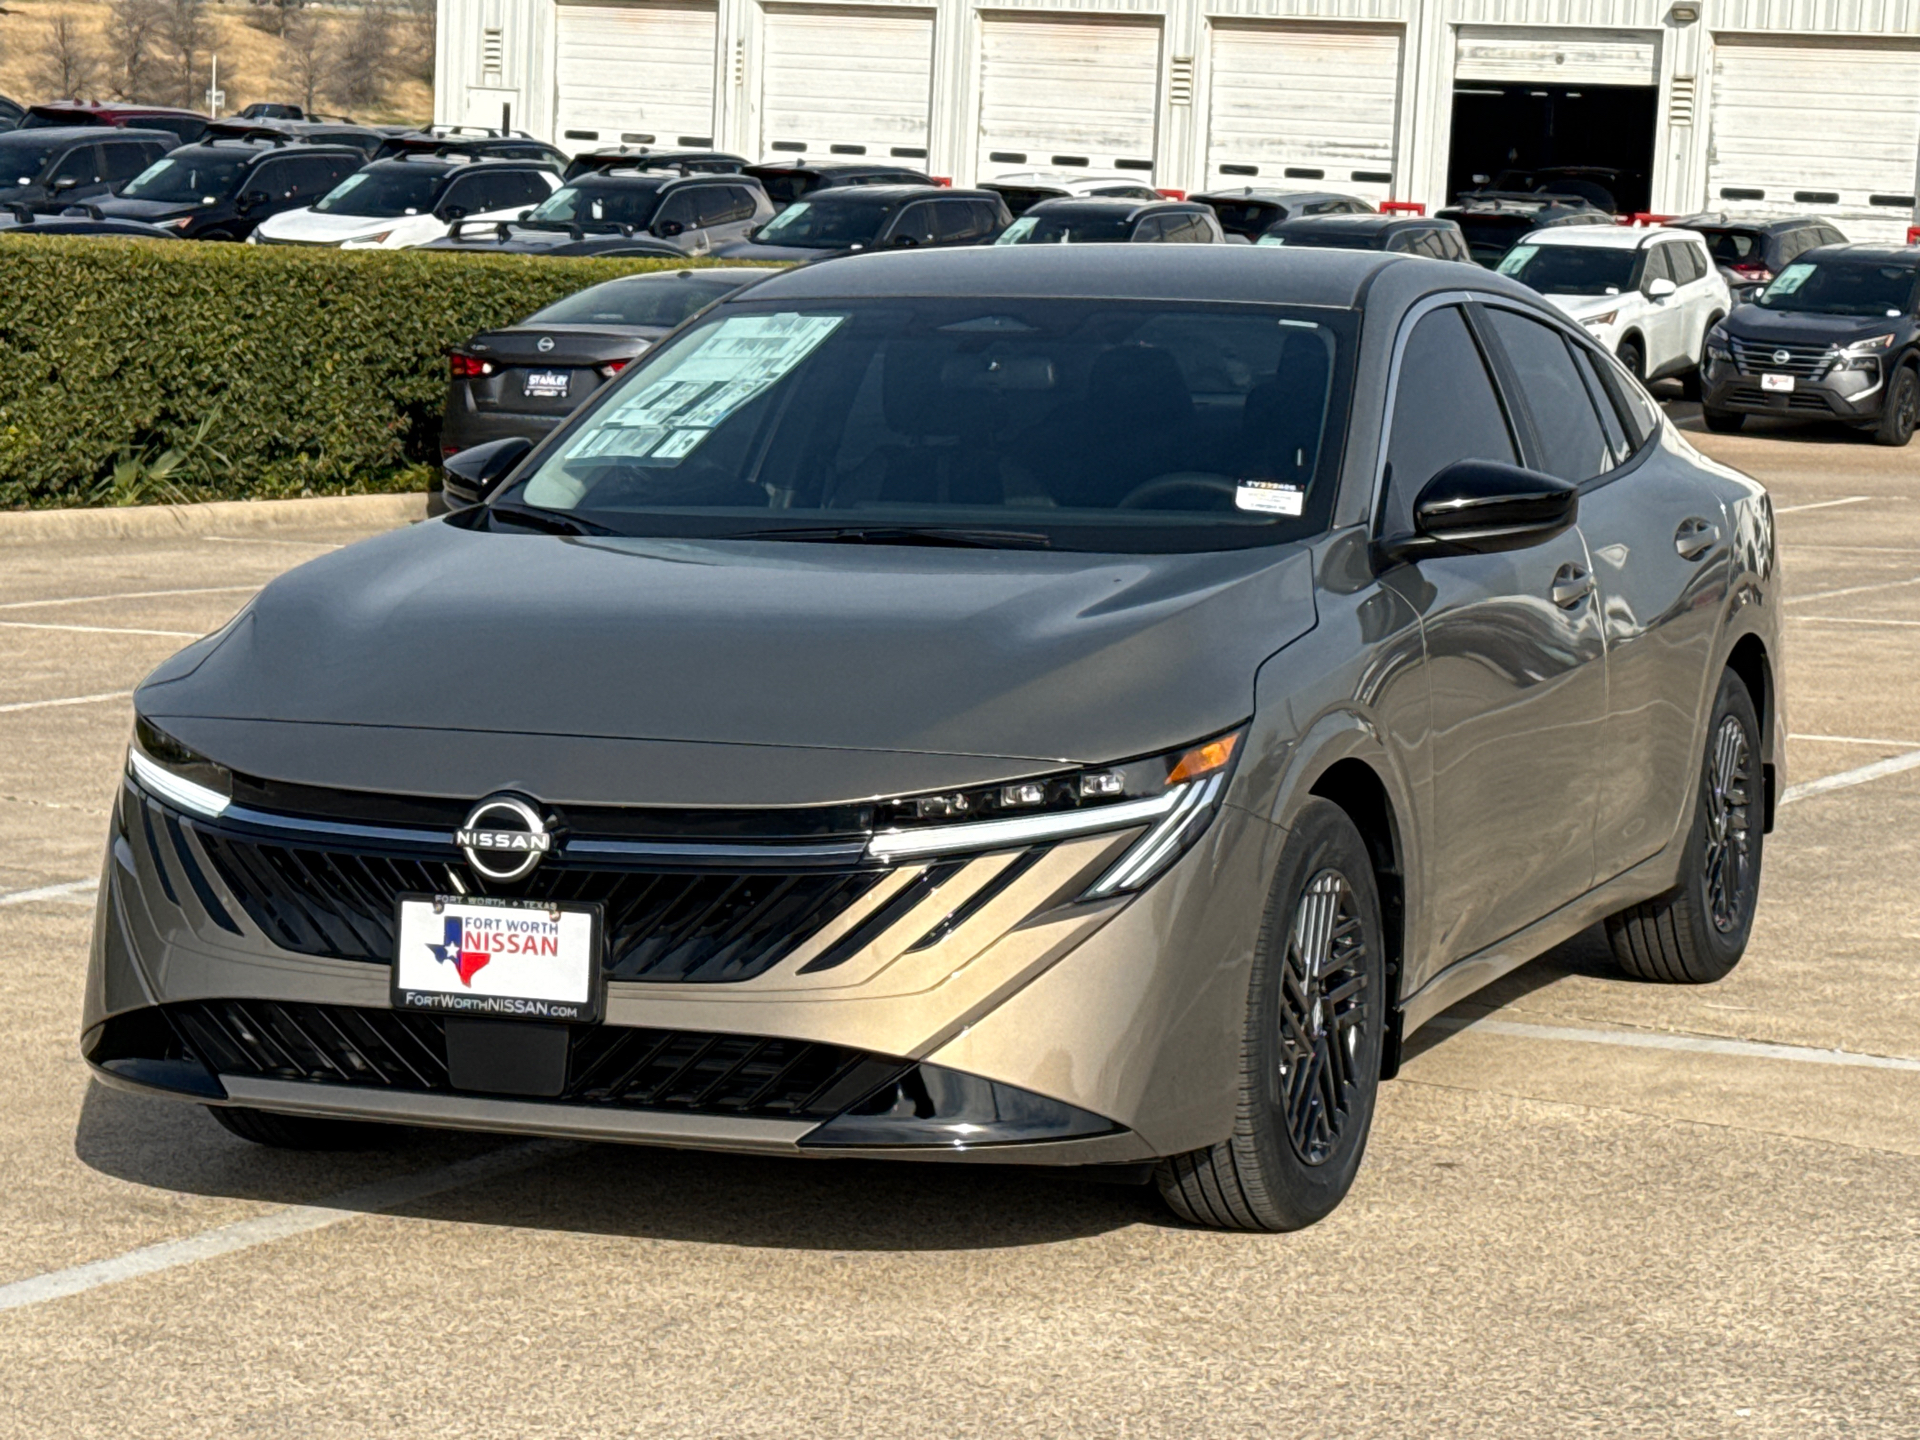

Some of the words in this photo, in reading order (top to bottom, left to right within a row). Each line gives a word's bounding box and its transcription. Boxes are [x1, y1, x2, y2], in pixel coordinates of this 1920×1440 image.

[529, 374, 569, 386] STANLEY
[457, 830, 548, 850] NISSAN
[435, 894, 463, 904] FORT
[468, 896, 506, 907] WORTH
[522, 900, 557, 911] TEXAS
[464, 917, 502, 930] FORT
[506, 919, 559, 935] WORTH
[464, 931, 559, 957] NISSAN
